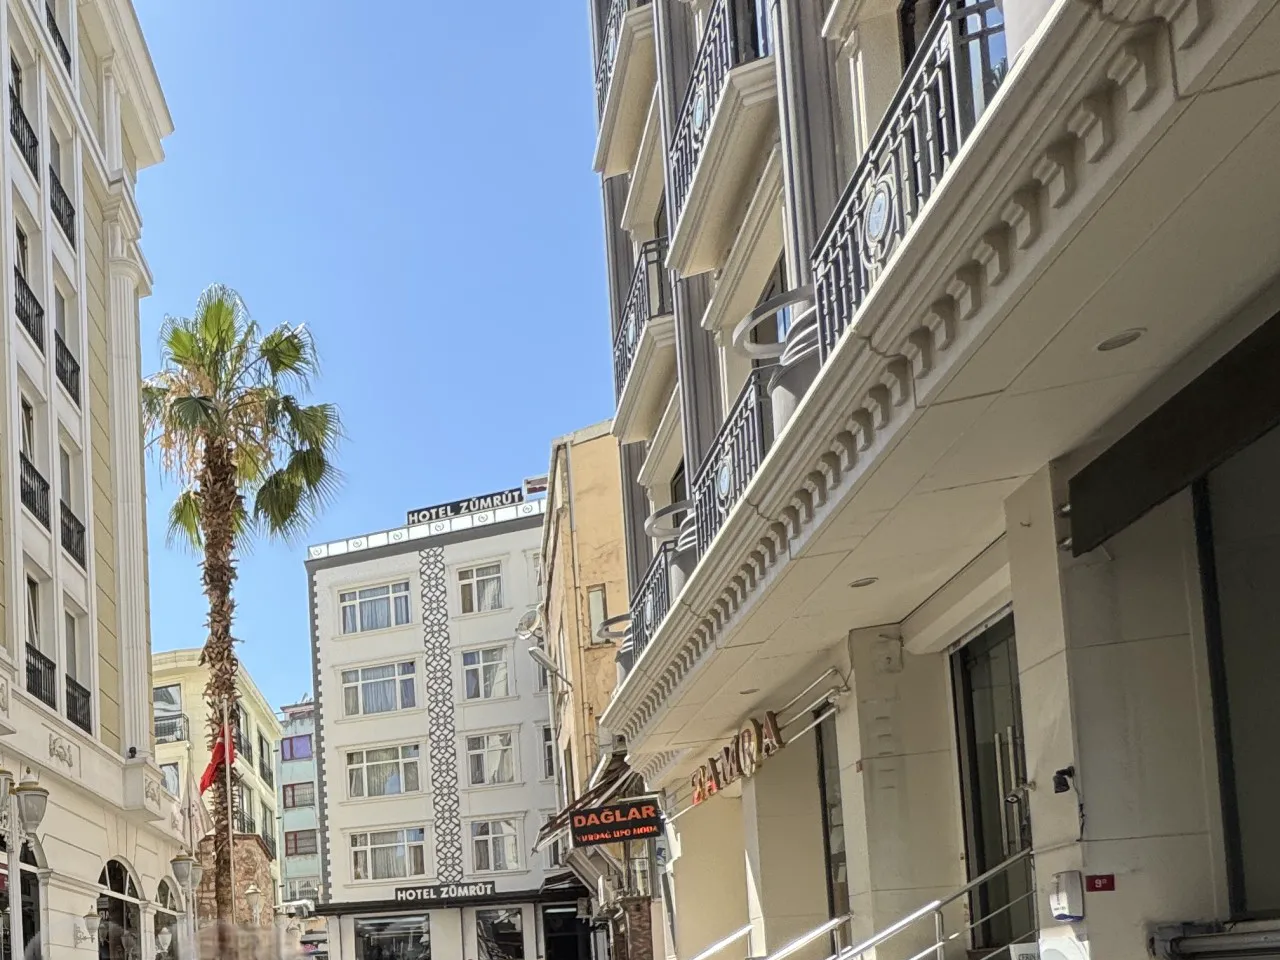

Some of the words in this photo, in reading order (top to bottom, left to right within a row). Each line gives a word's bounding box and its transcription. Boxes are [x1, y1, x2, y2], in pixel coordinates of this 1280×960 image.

[408, 505, 454, 524] HOTEL
[573, 804, 656, 828] DAĞLAR
[397, 888, 437, 901] HOTEL
